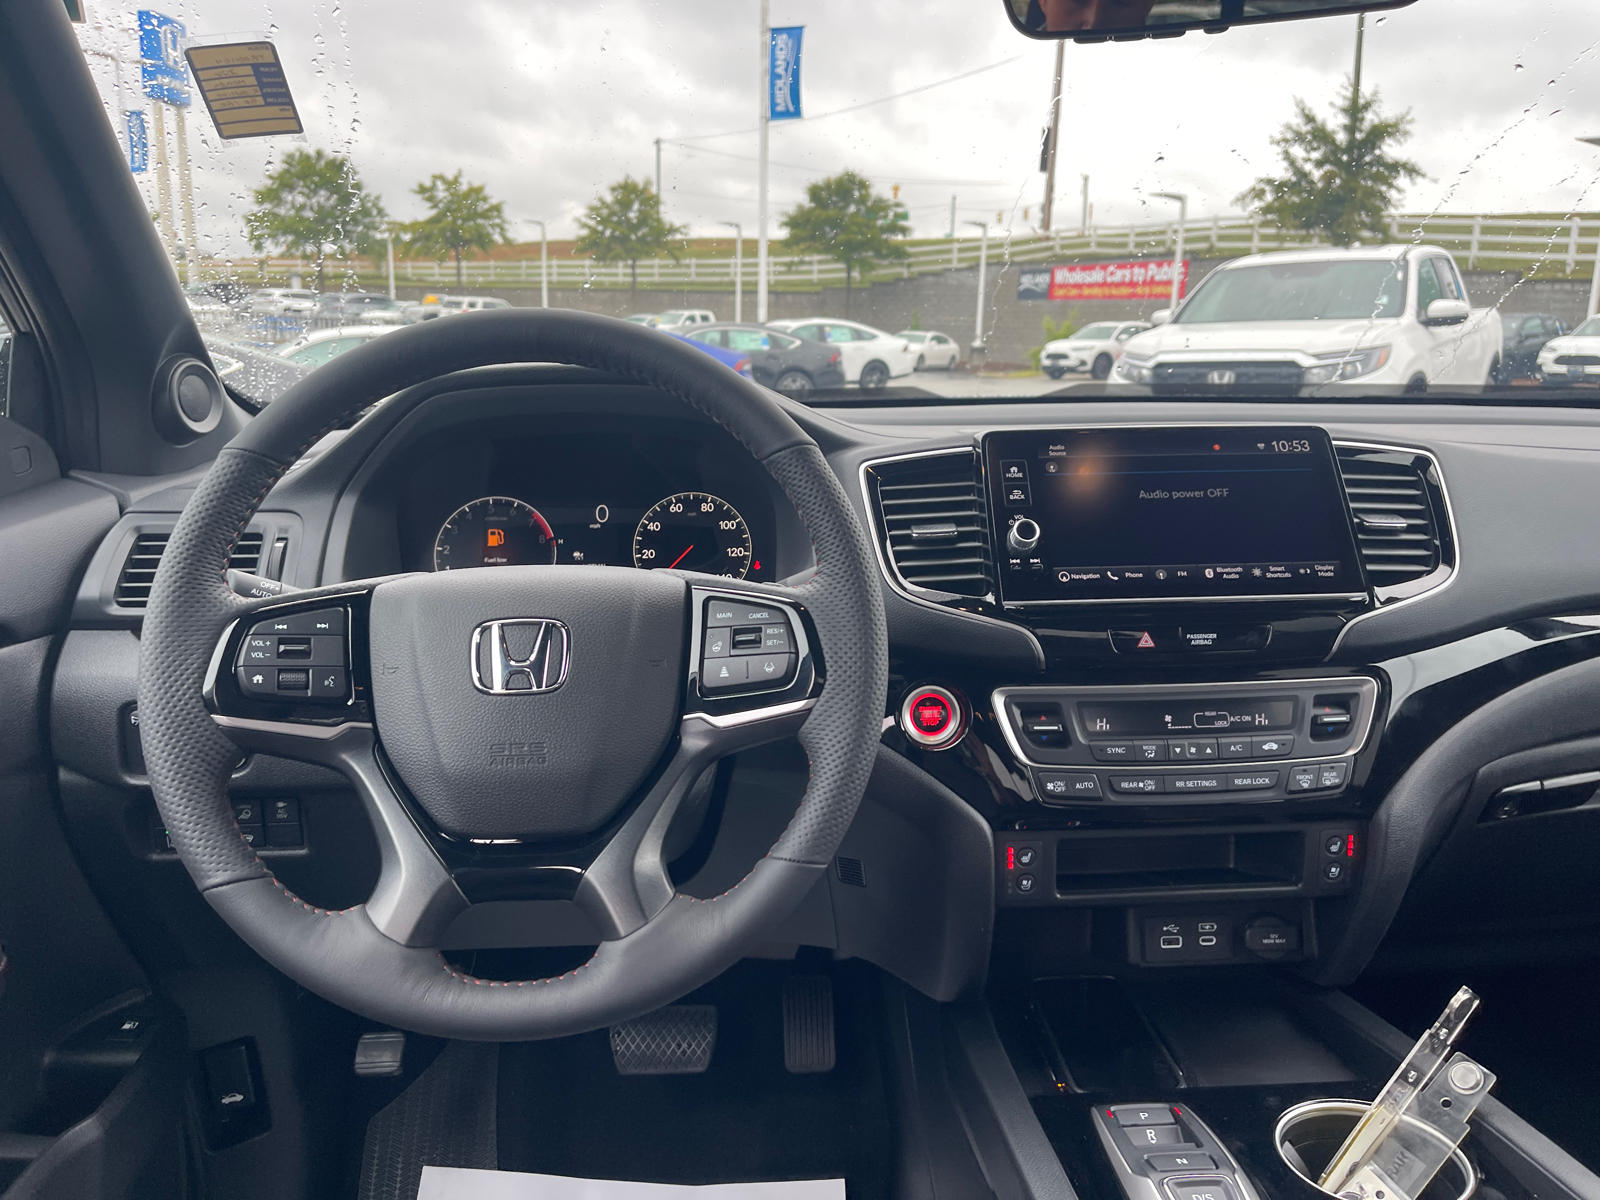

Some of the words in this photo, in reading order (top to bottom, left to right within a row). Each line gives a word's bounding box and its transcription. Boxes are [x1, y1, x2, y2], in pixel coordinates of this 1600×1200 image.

[774, 34, 788, 112] MIDLANDS
[1054, 266, 1104, 285] Wholesale
[1106, 264, 1131, 283] Cars
[1271, 440, 1310, 452] 10:53
[1138, 490, 1170, 499] Audio
[1172, 490, 1204, 500] power
[1207, 488, 1230, 498] OFF
[489, 505, 494, 513] 5
[510, 507, 516, 516] 6
[670, 503, 683, 513] 60
[701, 502, 714, 512] 80
[466, 512, 472, 520] 4
[596, 504, 609, 522] 0
[529, 519, 534, 527] 7
[647, 522, 661, 531] 40
[719, 521, 736, 530] 100
[452, 526, 458, 534] 3
[539, 535, 545, 543] 8
[443, 545, 450, 554] 2
[726, 548, 744, 557] 120
[642, 550, 655, 559] 20
[251, 588, 273, 597] AUTO
[490, 757, 548, 766] AIRBAG
[1146, 1130, 1156, 1140] R
